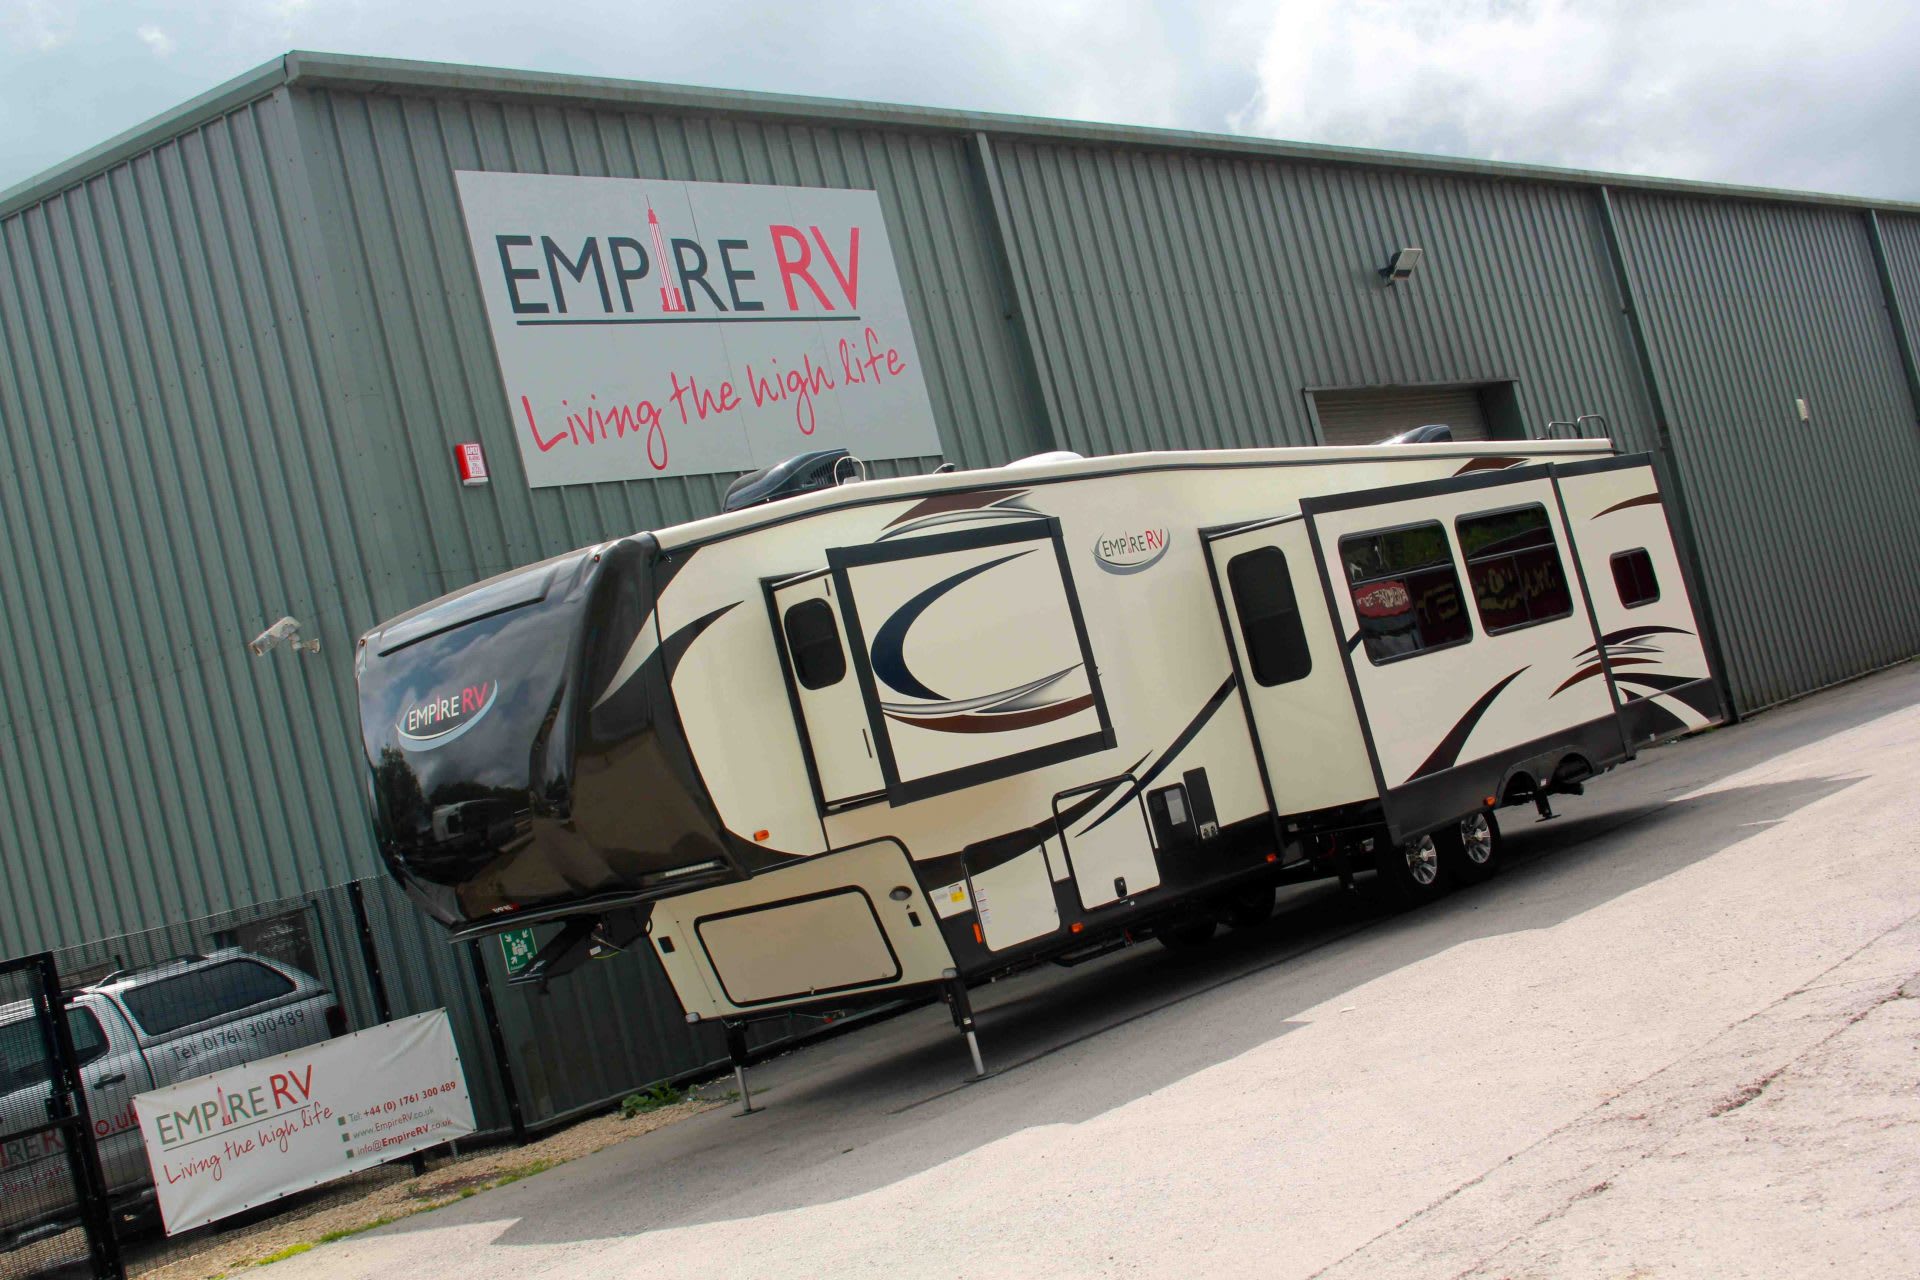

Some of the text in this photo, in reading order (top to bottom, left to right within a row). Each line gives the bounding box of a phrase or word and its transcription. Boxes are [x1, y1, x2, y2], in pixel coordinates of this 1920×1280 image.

[496, 198, 860, 314] EMPIRE RV
[522, 327, 905, 471] Living the high life
[1102, 528, 1163, 557] EMPIRE RV
[408, 682, 488, 731] EMPIRE RV
[202, 1029, 242, 1051] 01761
[246, 1009, 304, 1037] 300489
[156, 1064, 312, 1145] EMPIRE RV
[363, 1105, 381, 1116] +44
[383, 1101, 397, 1113] (0)
[399, 1093, 419, 1106] 1761
[422, 1087, 438, 1099] 300
[440, 1081, 456, 1093] 489
[163, 1101, 333, 1184] Living the high life
[353, 1106, 435, 1139] www.EmpireRV.co.uk
[357, 1118, 453, 1155] info@EmpireRV.co.uk
